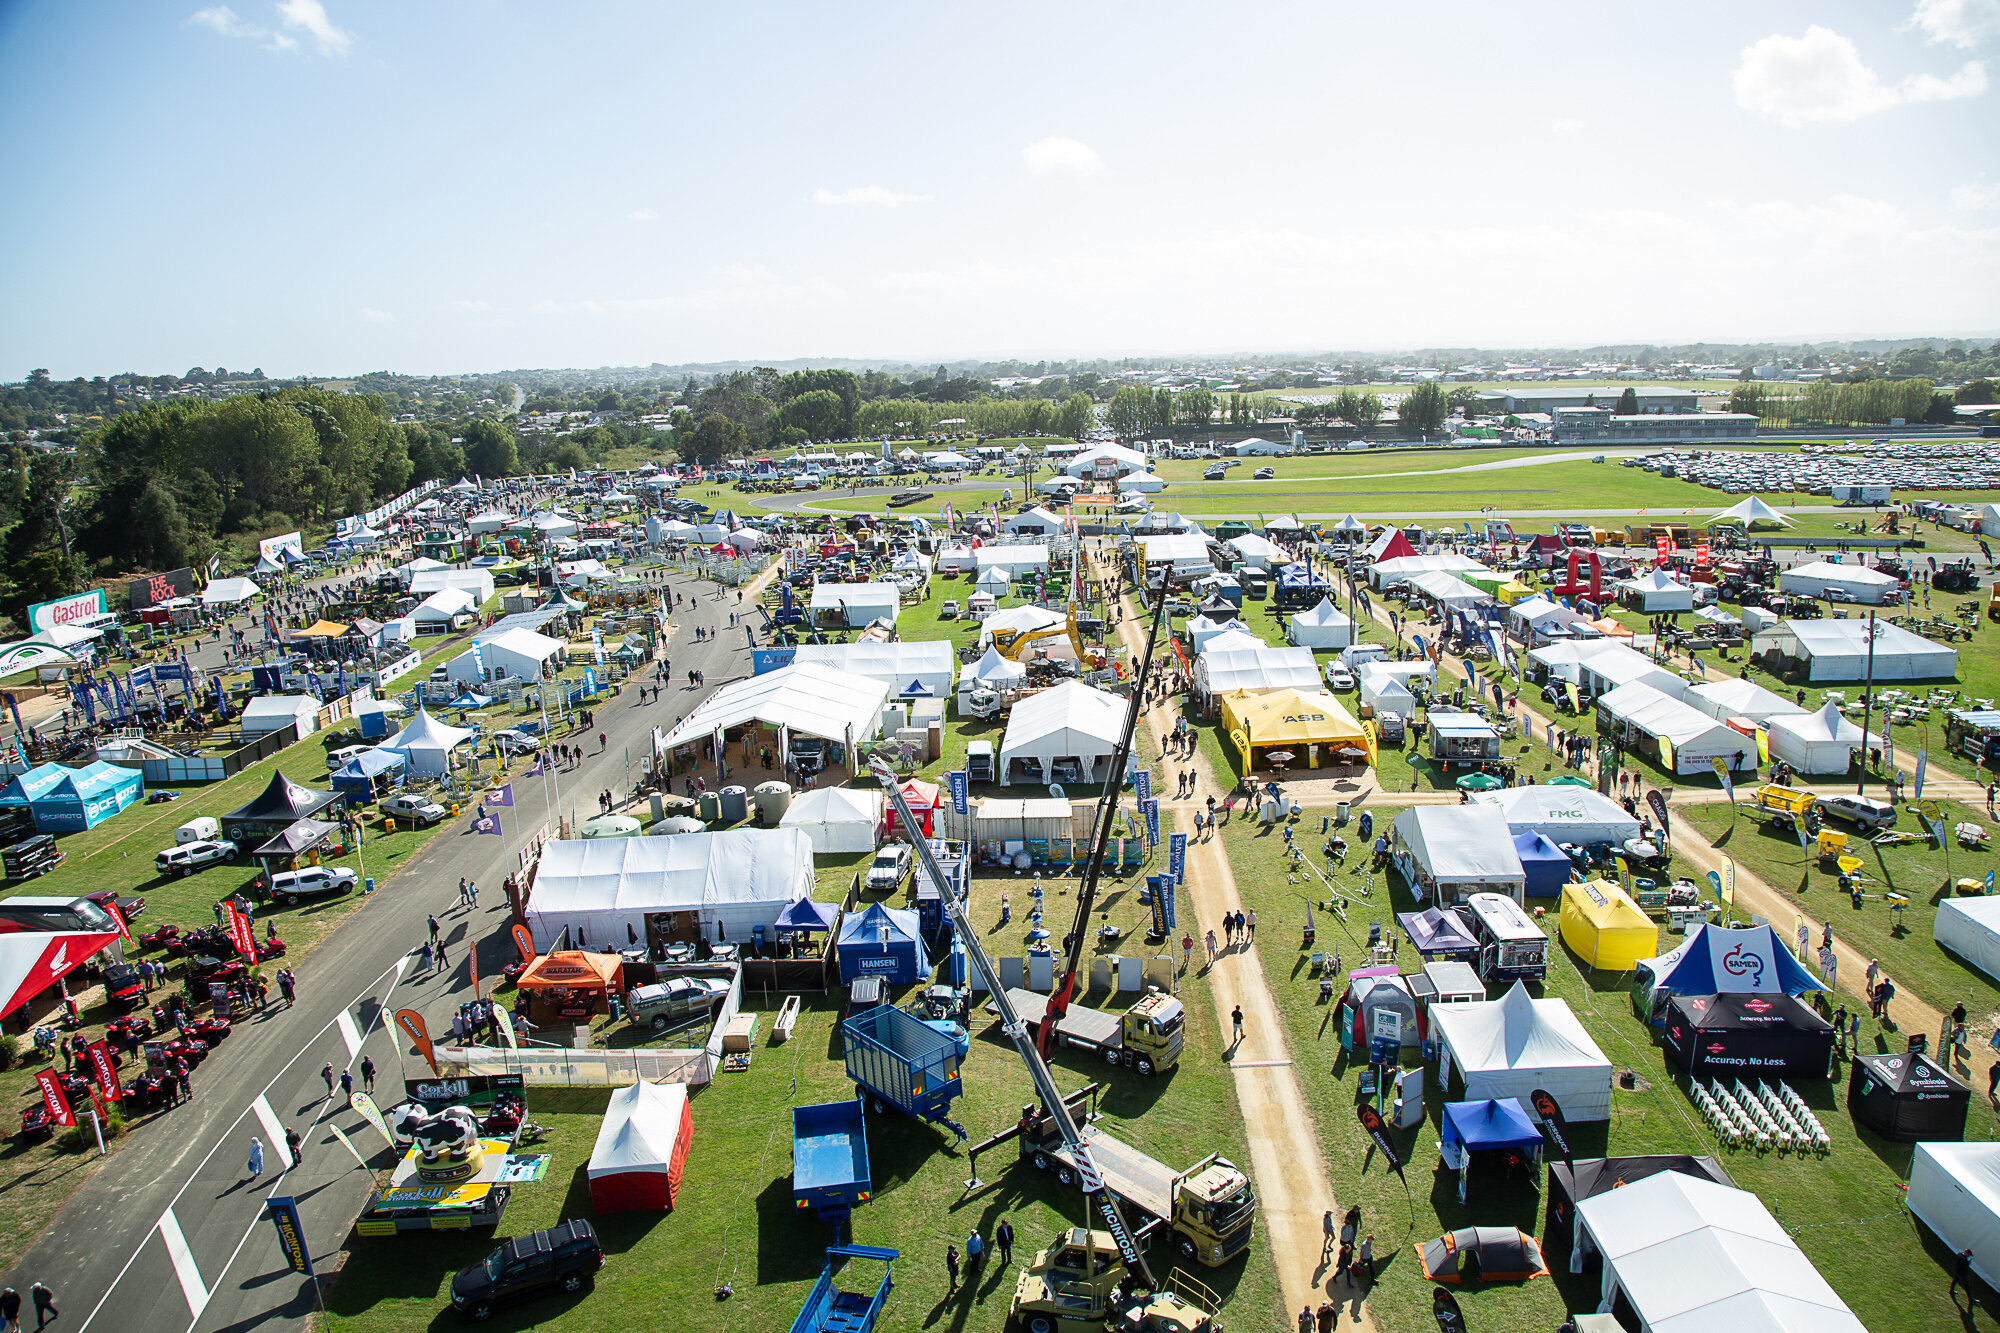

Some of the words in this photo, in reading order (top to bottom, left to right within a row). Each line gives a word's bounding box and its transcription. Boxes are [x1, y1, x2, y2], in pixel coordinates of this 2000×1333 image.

[272, 538, 301, 553] SUZUKI
[148, 575, 167, 590] THE
[150, 584, 177, 602] ROCK
[53, 596, 97, 624] Castrol
[773, 655, 790, 663] LIC
[1284, 714, 1325, 723] ASB
[955, 778, 964, 811] HANSEN
[1549, 810, 1583, 818] FMG
[1652, 798, 1667, 821] CRAIGS
[1174, 836, 1183, 860] VALVES
[1154, 895, 1164, 932] MCINTOSH
[546, 967, 584, 975] WARATAH
[861, 958, 896, 968] HANSEN
[1728, 960, 1759, 968] SAMEN
[403, 1016, 422, 1038] WARATAH
[1704, 1056, 1748, 1066] Accuracy.
[1750, 1057, 1762, 1065] No
[1764, 1057, 1786, 1065] Less.
[417, 1080, 468, 1094] Corkill
[1546, 1118, 1570, 1153] BUSHBUCK
[1373, 1131, 1398, 1163] BUSHBUCK
[388, 1186, 444, 1200] Corkill
[1101, 1204, 1138, 1264] MCINTOSH
[281, 1224, 305, 1271] MCINTOSH
